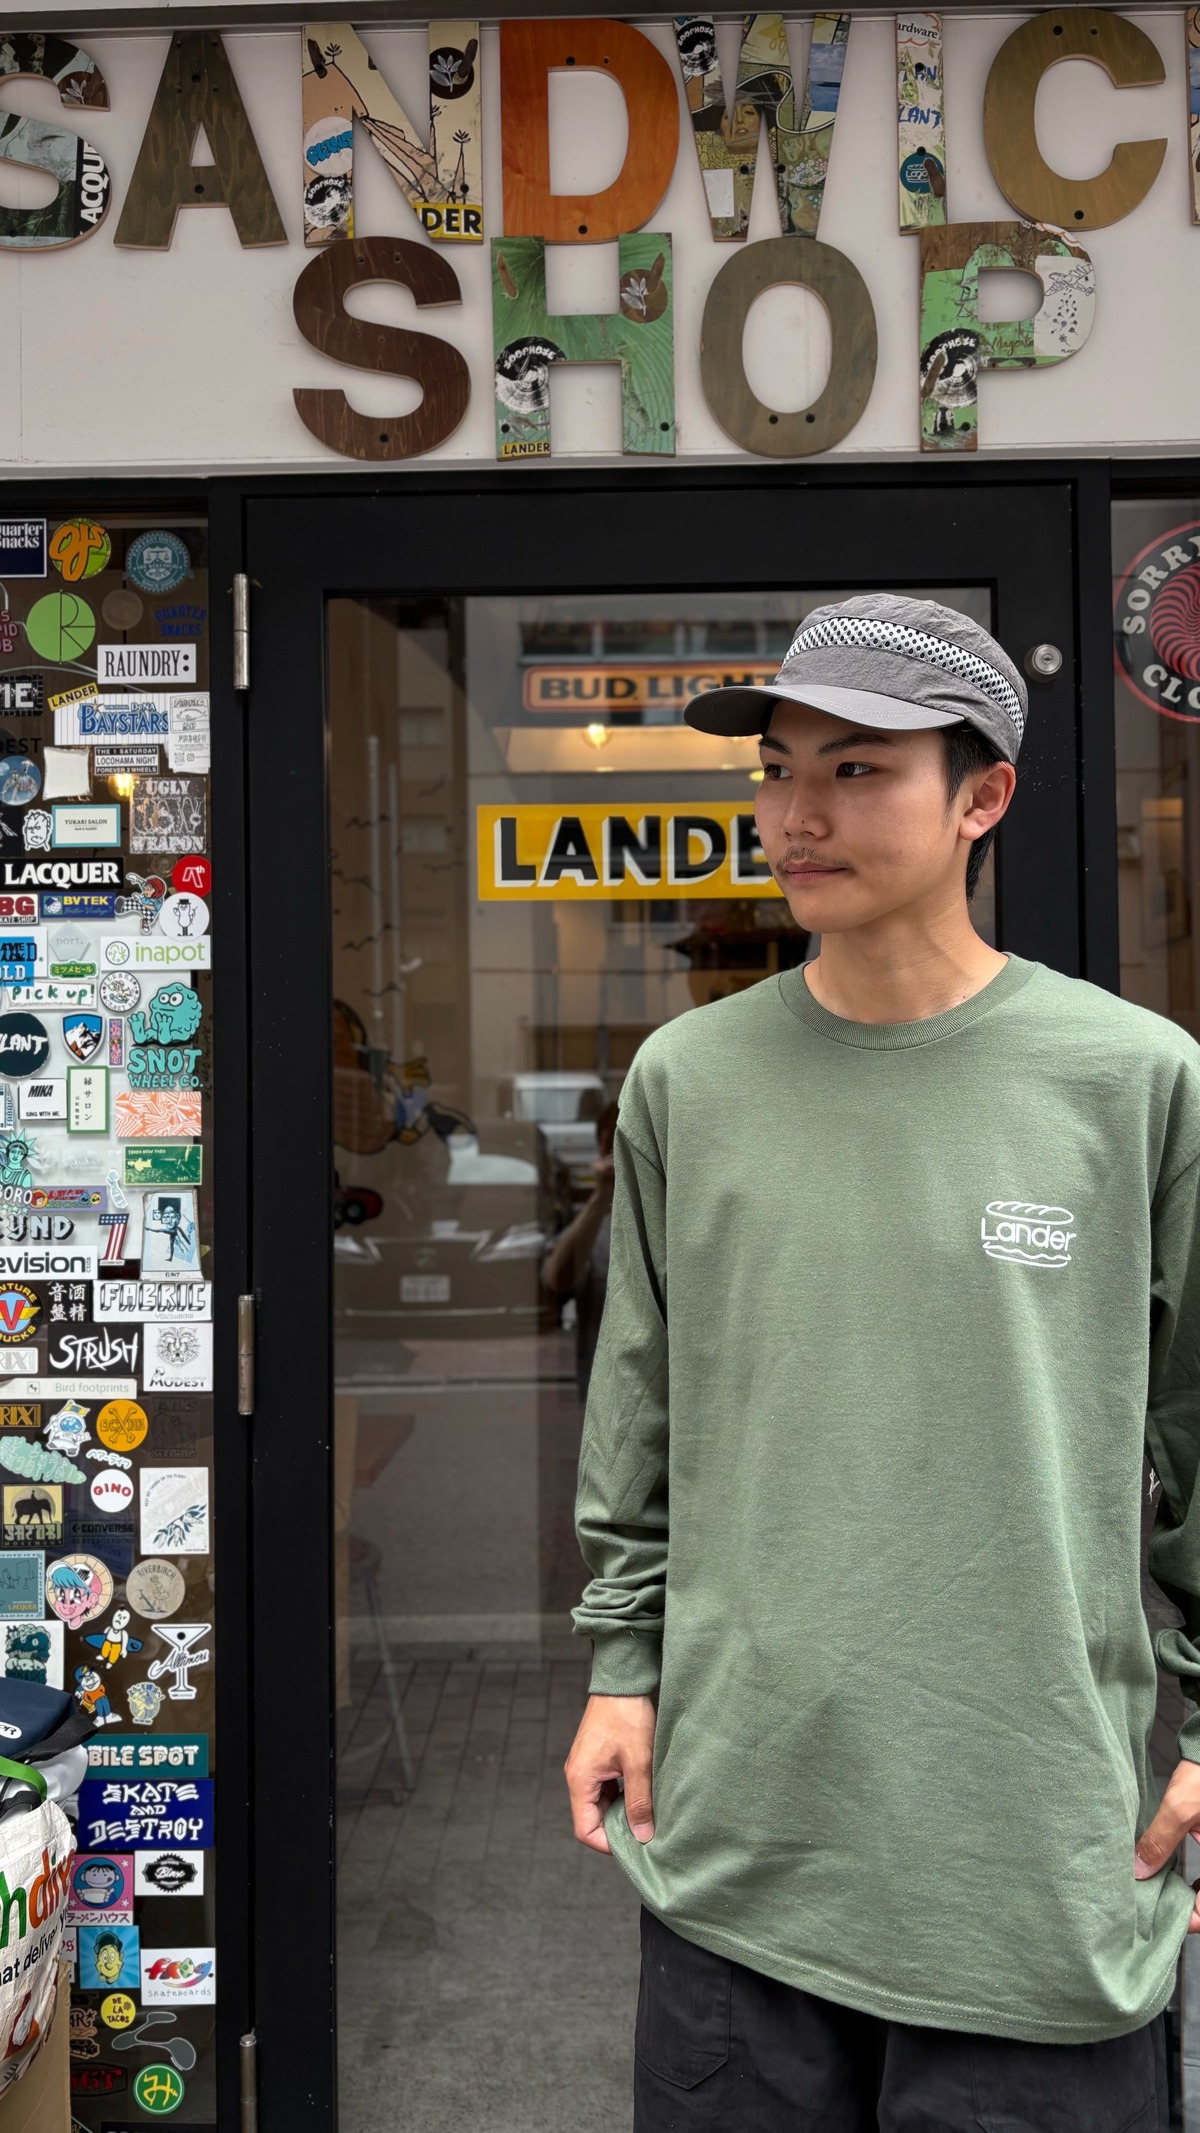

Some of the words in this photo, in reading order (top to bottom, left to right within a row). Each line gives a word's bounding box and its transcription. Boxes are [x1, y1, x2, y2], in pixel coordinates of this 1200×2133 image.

[293, 222, 1096, 461] SHOP
[503, 444, 550, 456] LANDER
[0, 523, 43, 537] uarter
[0, 537, 41, 549] nacks
[539, 677, 636, 700] BUD
[51, 686, 97, 709] LANDER
[119, 747, 157, 755] SATURDAY
[96, 757, 135, 765] LOCOHAMA
[136, 756, 156, 765] NIGHT
[145, 780, 190, 796] UGLY
[4, 862, 121, 889] LACQUER
[135, 941, 205, 965] inapot
[127, 1048, 203, 1075] SNOT
[127, 1074, 177, 1089] WHEEL
[28, 1085, 55, 1098] MIKA
[40, 1110, 52, 1118] WITH
[981, 1217, 1077, 1252] Lander
[100, 1282, 206, 1312] FABRIC
[49, 1326, 138, 1373] STRUSH
[55, 1383, 76, 1392] Bird
[78, 1382, 130, 1394] footprints
[81, 1523, 135, 1533] CONVERSE
[137, 1564, 177, 1581] RIVERBIRCH
[138, 1744, 200, 1766] SPOT
[102, 1782, 199, 1805] SKATE
[129, 1804, 167, 1816] AND
[88, 1817, 204, 1847] DESTROY
[67, 1912, 131, 1924] ラーメンハウス
[112, 1997, 123, 2005] DE
[112, 2005, 124, 2014] LA
[106, 2015, 130, 2024] TACOS
